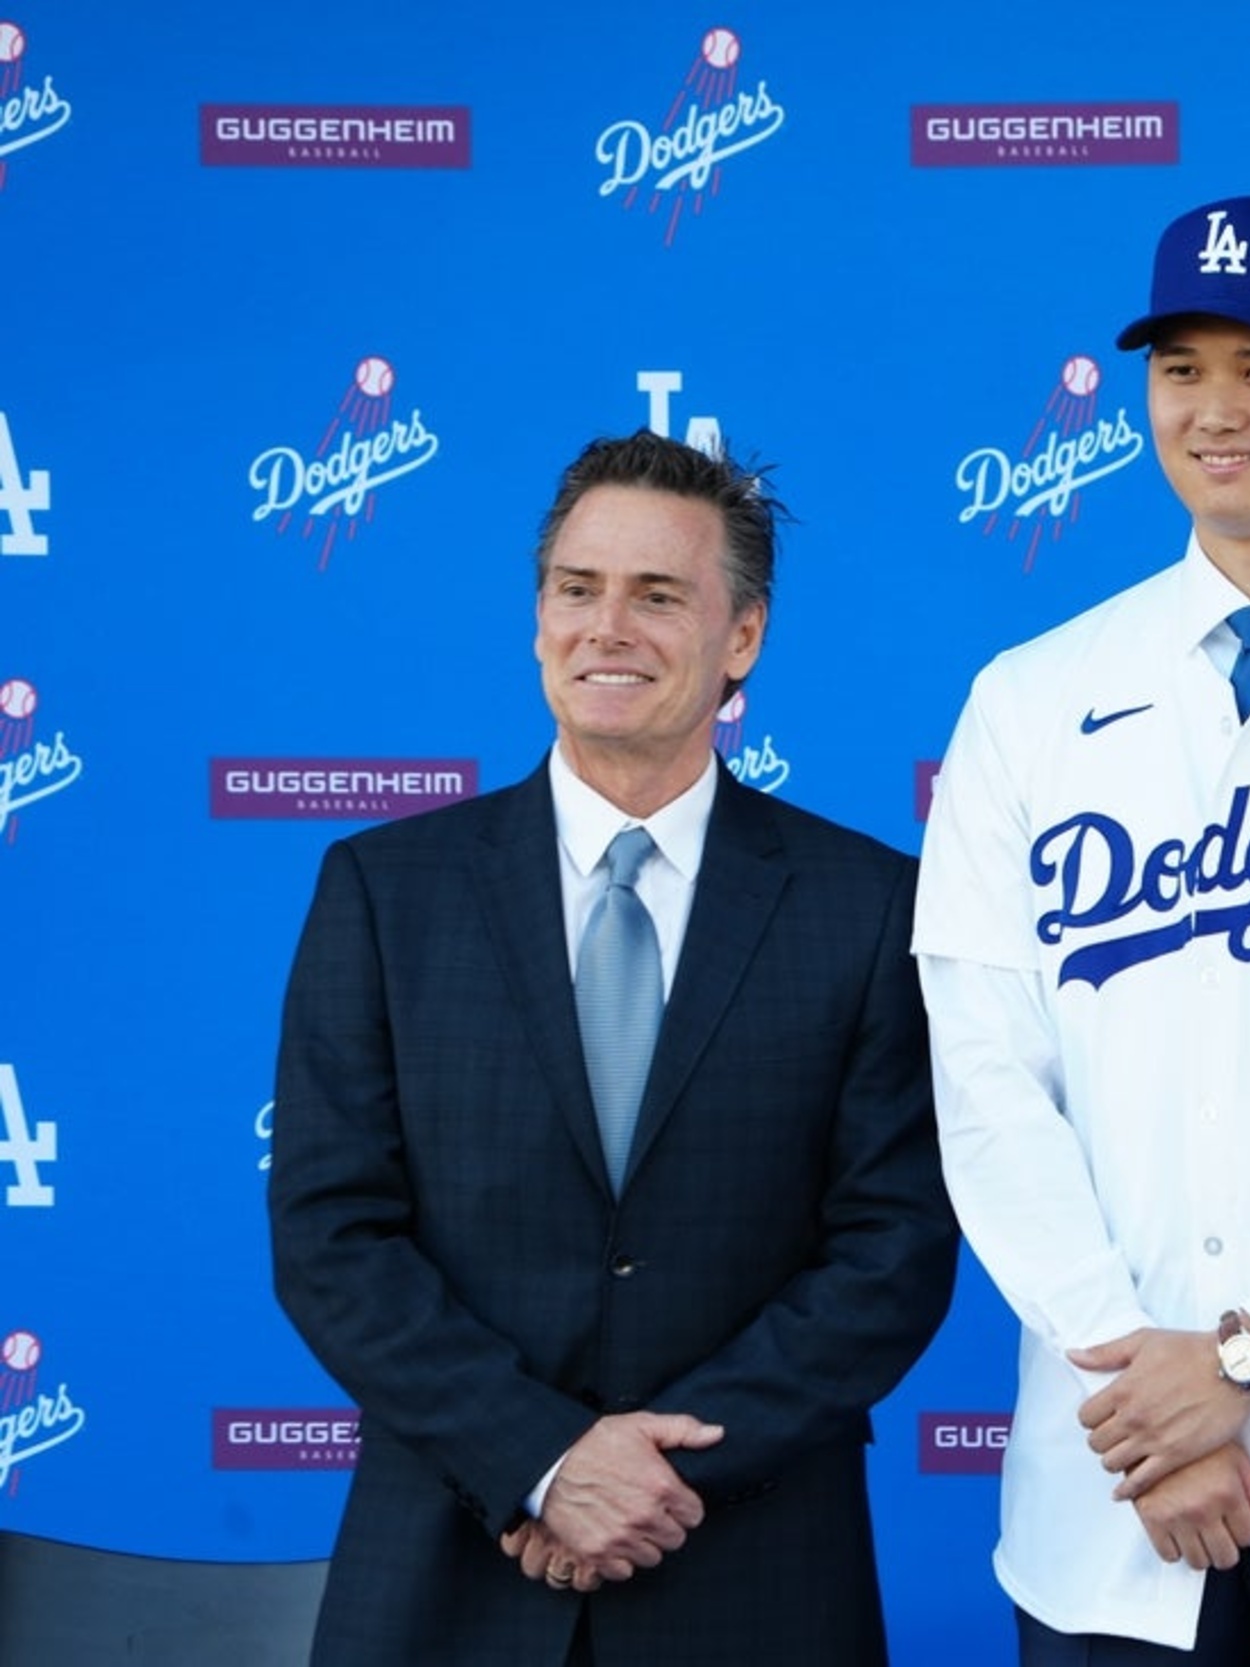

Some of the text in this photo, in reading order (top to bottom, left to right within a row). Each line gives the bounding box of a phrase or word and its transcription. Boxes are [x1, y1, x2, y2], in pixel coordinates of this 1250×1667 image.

[216, 118, 455, 142] GUGGENHEIM
[596, 80, 784, 197] Dodgers
[927, 115, 1162, 140] GUGGENHEIM
[1198, 211, 1247, 274] LA
[249, 408, 438, 522] Dodgers
[956, 408, 1143, 523] Dodgers
[226, 771, 462, 794] GUGGENHEIM
[229, 1421, 362, 1444] GUGGE
